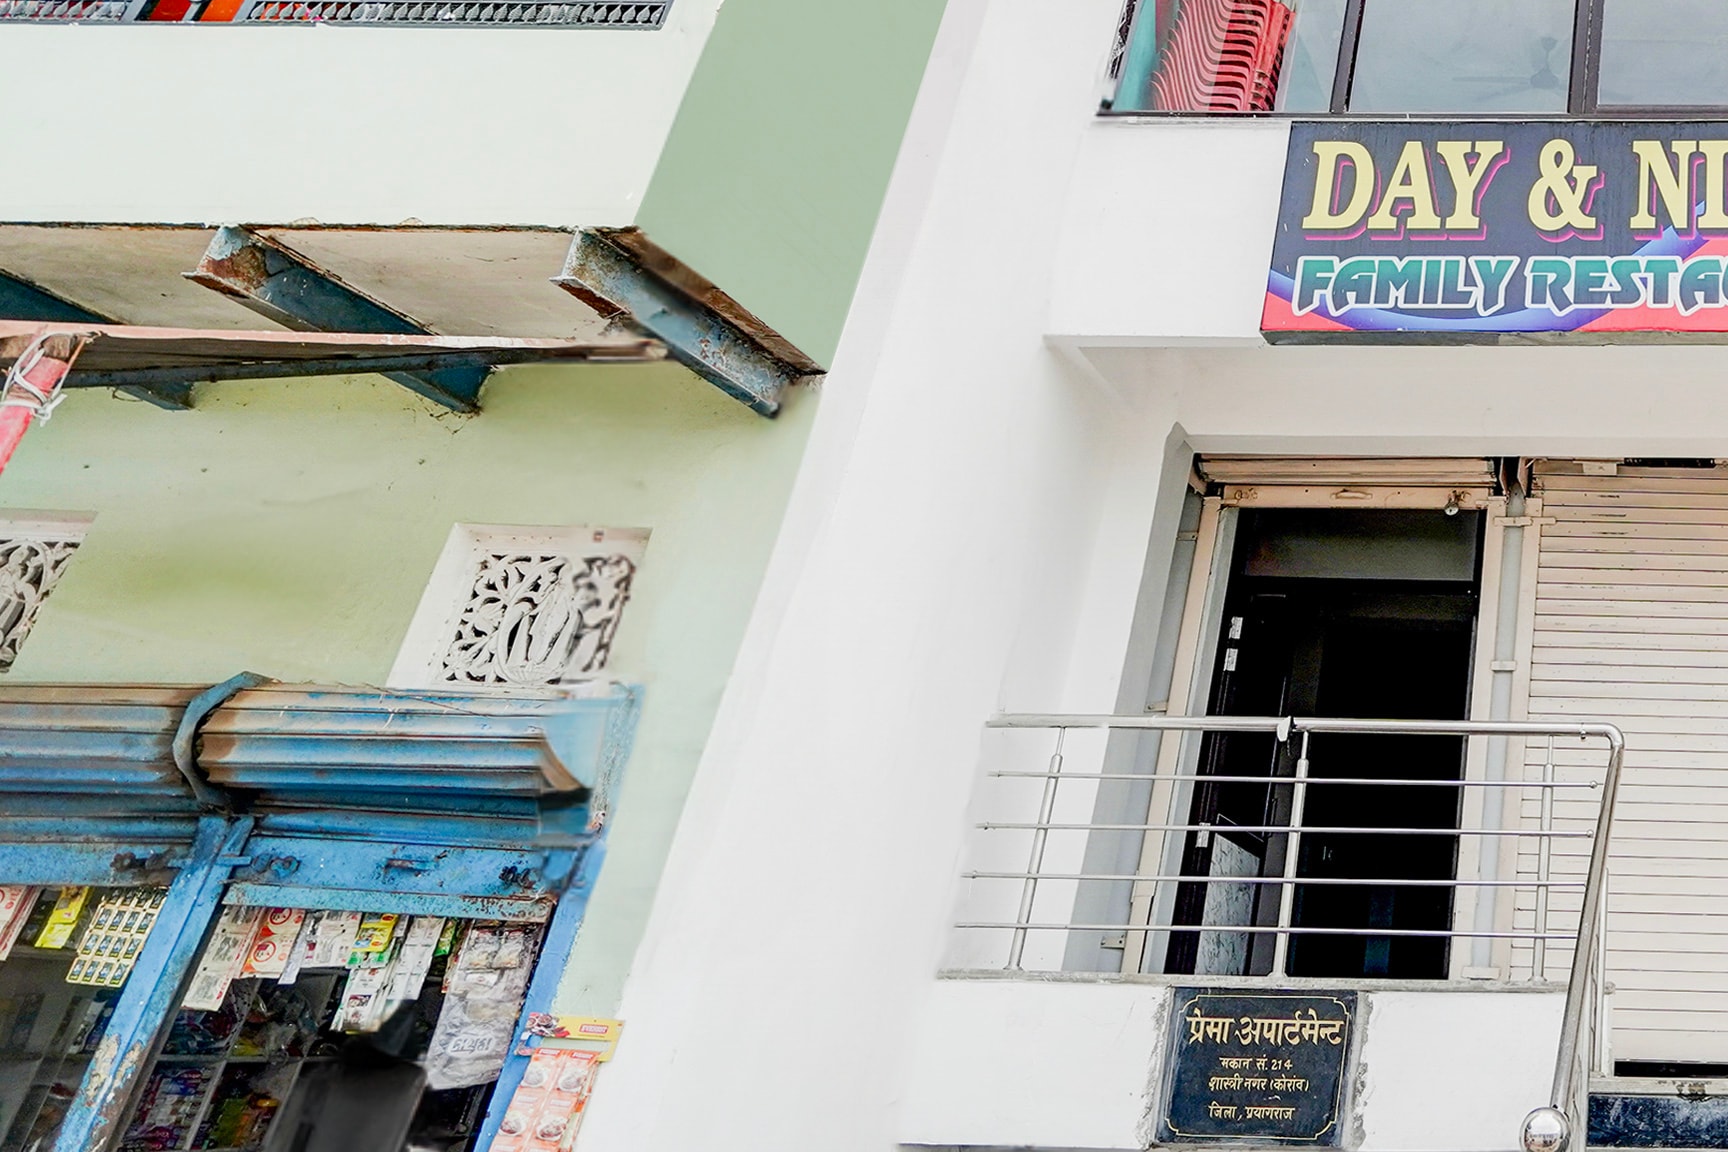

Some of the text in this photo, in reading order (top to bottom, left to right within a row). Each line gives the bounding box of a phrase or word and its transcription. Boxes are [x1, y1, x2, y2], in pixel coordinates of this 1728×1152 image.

[1301, 139, 1510, 233] DAY
[1529, 139, 1600, 233] &
[1291, 255, 1521, 317] FAMILY
[1186, 1007, 1345, 1046] प्रेमा अपार्टमेन्ट
[1219, 1054, 1293, 1071] मकान सं. 214
[1208, 1073, 1243, 1092] शास्त्री
[1243, 1078, 1268, 1091] नगर
[1245, 1106, 1296, 1121] प्रयागराज
